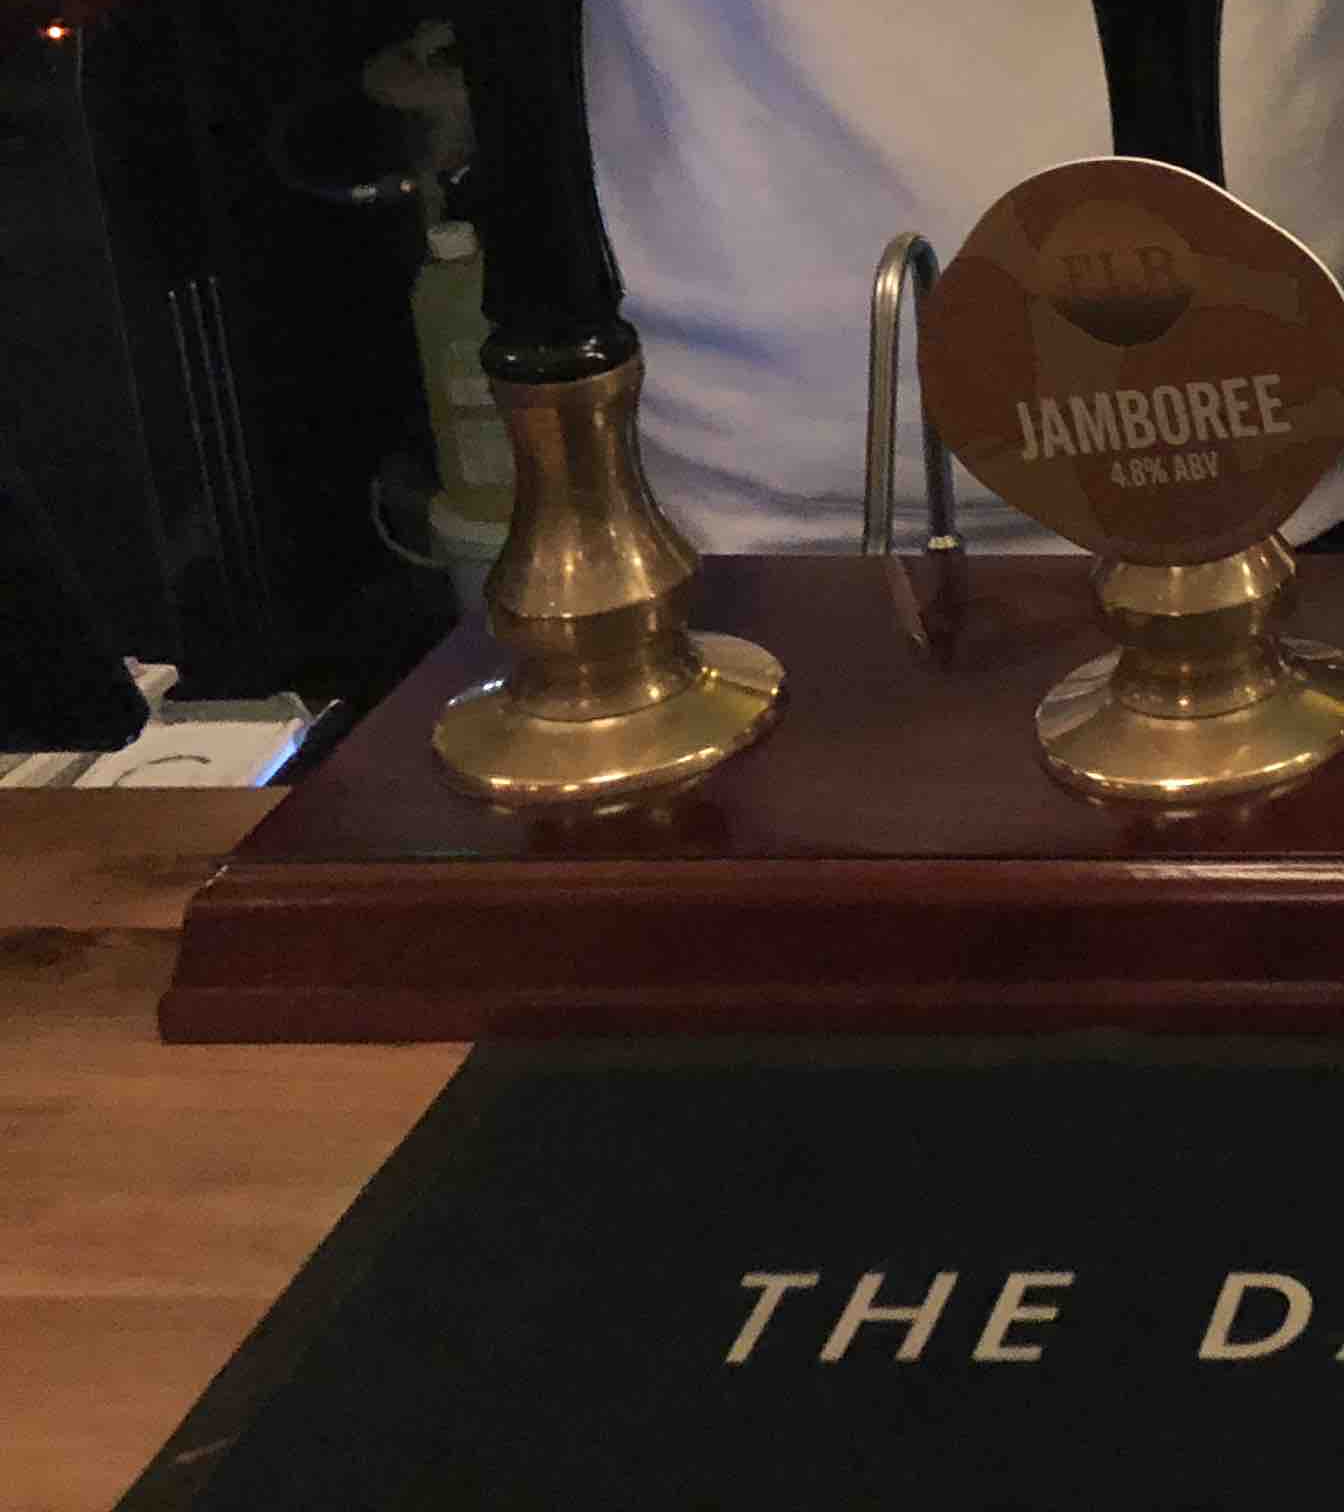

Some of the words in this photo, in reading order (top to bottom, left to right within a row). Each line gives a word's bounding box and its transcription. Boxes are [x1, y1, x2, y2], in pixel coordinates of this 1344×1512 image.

[1014, 373, 1293, 462] JAMBOREE
[1109, 453, 1170, 489] 4.8%
[1172, 448, 1219, 482] ABV
[725, 1272, 1075, 1363] THE
